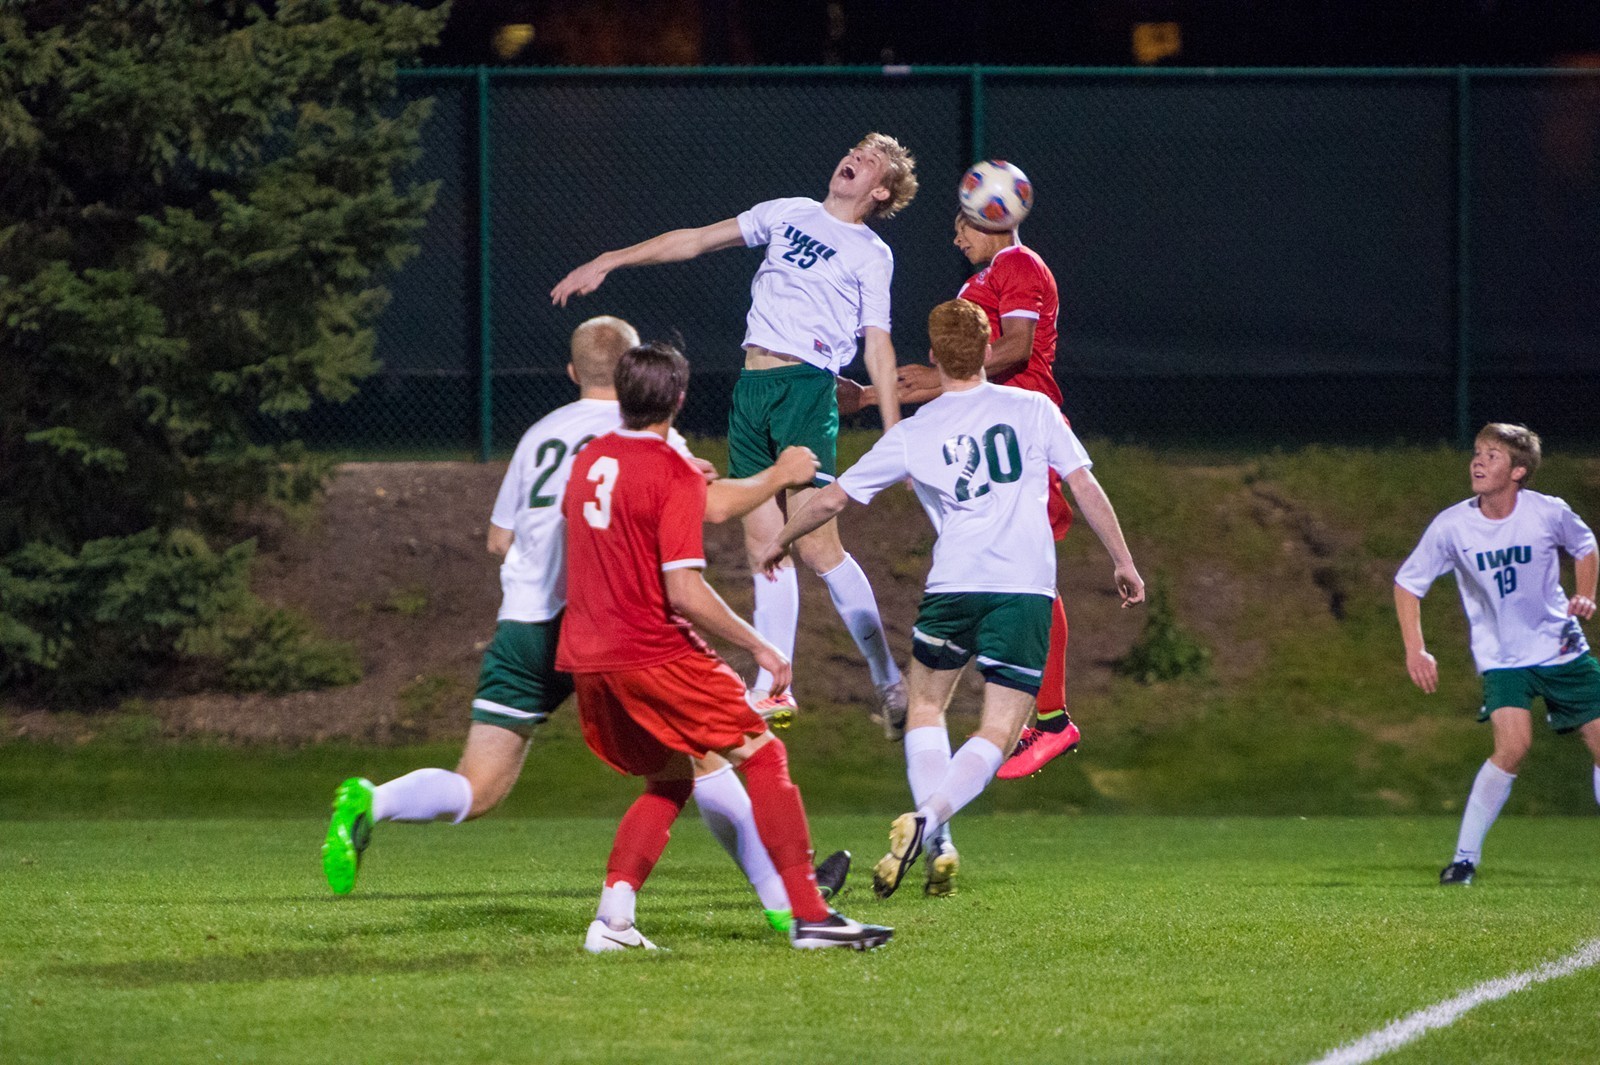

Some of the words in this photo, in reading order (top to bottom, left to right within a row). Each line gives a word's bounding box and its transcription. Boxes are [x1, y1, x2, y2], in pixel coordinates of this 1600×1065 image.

[782, 239, 818, 269] 25
[529, 434, 598, 509] 2
[942, 423, 1023, 502] 20
[583, 456, 619, 529] 3
[1476, 545, 1532, 571] IWU
[1493, 566, 1517, 598] 19
